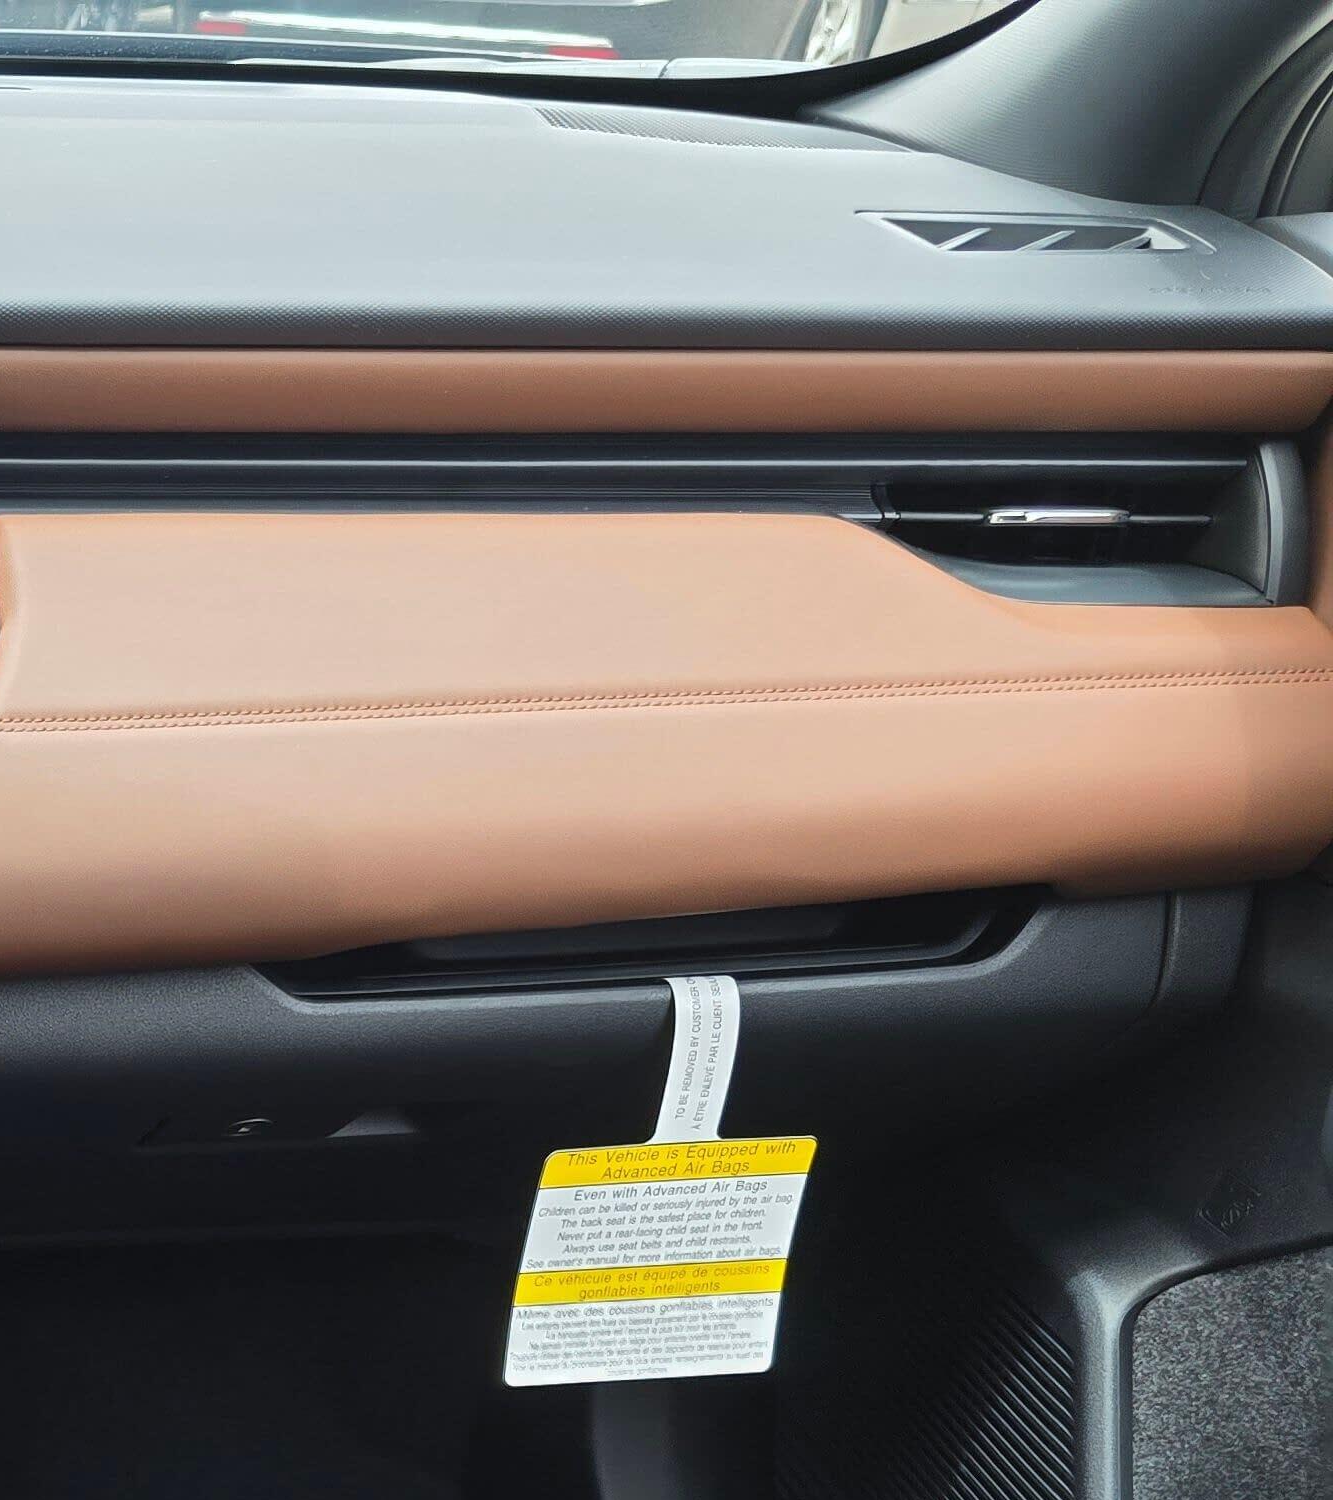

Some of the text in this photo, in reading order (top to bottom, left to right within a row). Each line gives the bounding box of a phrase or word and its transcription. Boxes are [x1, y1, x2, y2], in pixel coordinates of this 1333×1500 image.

[712, 1000, 722, 1029] CLIENT
[712, 1033, 721, 1046] LE
[675, 987, 701, 1119] TO BE REMOVED BY CUSTOMER
[708, 1046, 719, 1063] PAR
[567, 1141, 796, 1166] This Vehicle is Equipped with
[601, 1160, 750, 1179] Advanced Air Bags
[574, 1181, 767, 1201] Even with Advanced Air Bags
[538, 1194, 773, 1218] Children can be killed or seriously injured by the air
[561, 1219, 578, 1229] The
[581, 1217, 602, 1227] back
[606, 1216, 626, 1226] seat
[628, 1215, 636, 1225] is
[640, 1214, 654, 1223] the
[656, 1213, 685, 1223] safest
[687, 1212, 711, 1223] place
[715, 1210, 727, 1219] for
[557, 1231, 584, 1241] Never
[587, 1230, 603, 1241] put
[665, 1225, 687, 1236] child
[690, 1224, 709, 1234] seat
[712, 1223, 721, 1232] in
[724, 1222, 738, 1232] the
[563, 1244, 594, 1254] Always
[598, 1243, 615, 1251] use
[618, 1241, 637, 1251] seat
[640, 1240, 662, 1250] belts
[665, 1237, 682, 1248] and
[685, 1236, 707, 1246] child
[526, 1259, 544, 1269] See
[586, 1255, 620, 1265] manual
[622, 1254, 635, 1263] for
[638, 1254, 661, 1262] more
[716, 1248, 741, 1258] about
[534, 1275, 552, 1287] Ce
[618, 1272, 637, 1282] est
[692, 1267, 708, 1278] de
[714, 1264, 770, 1277] coussins
